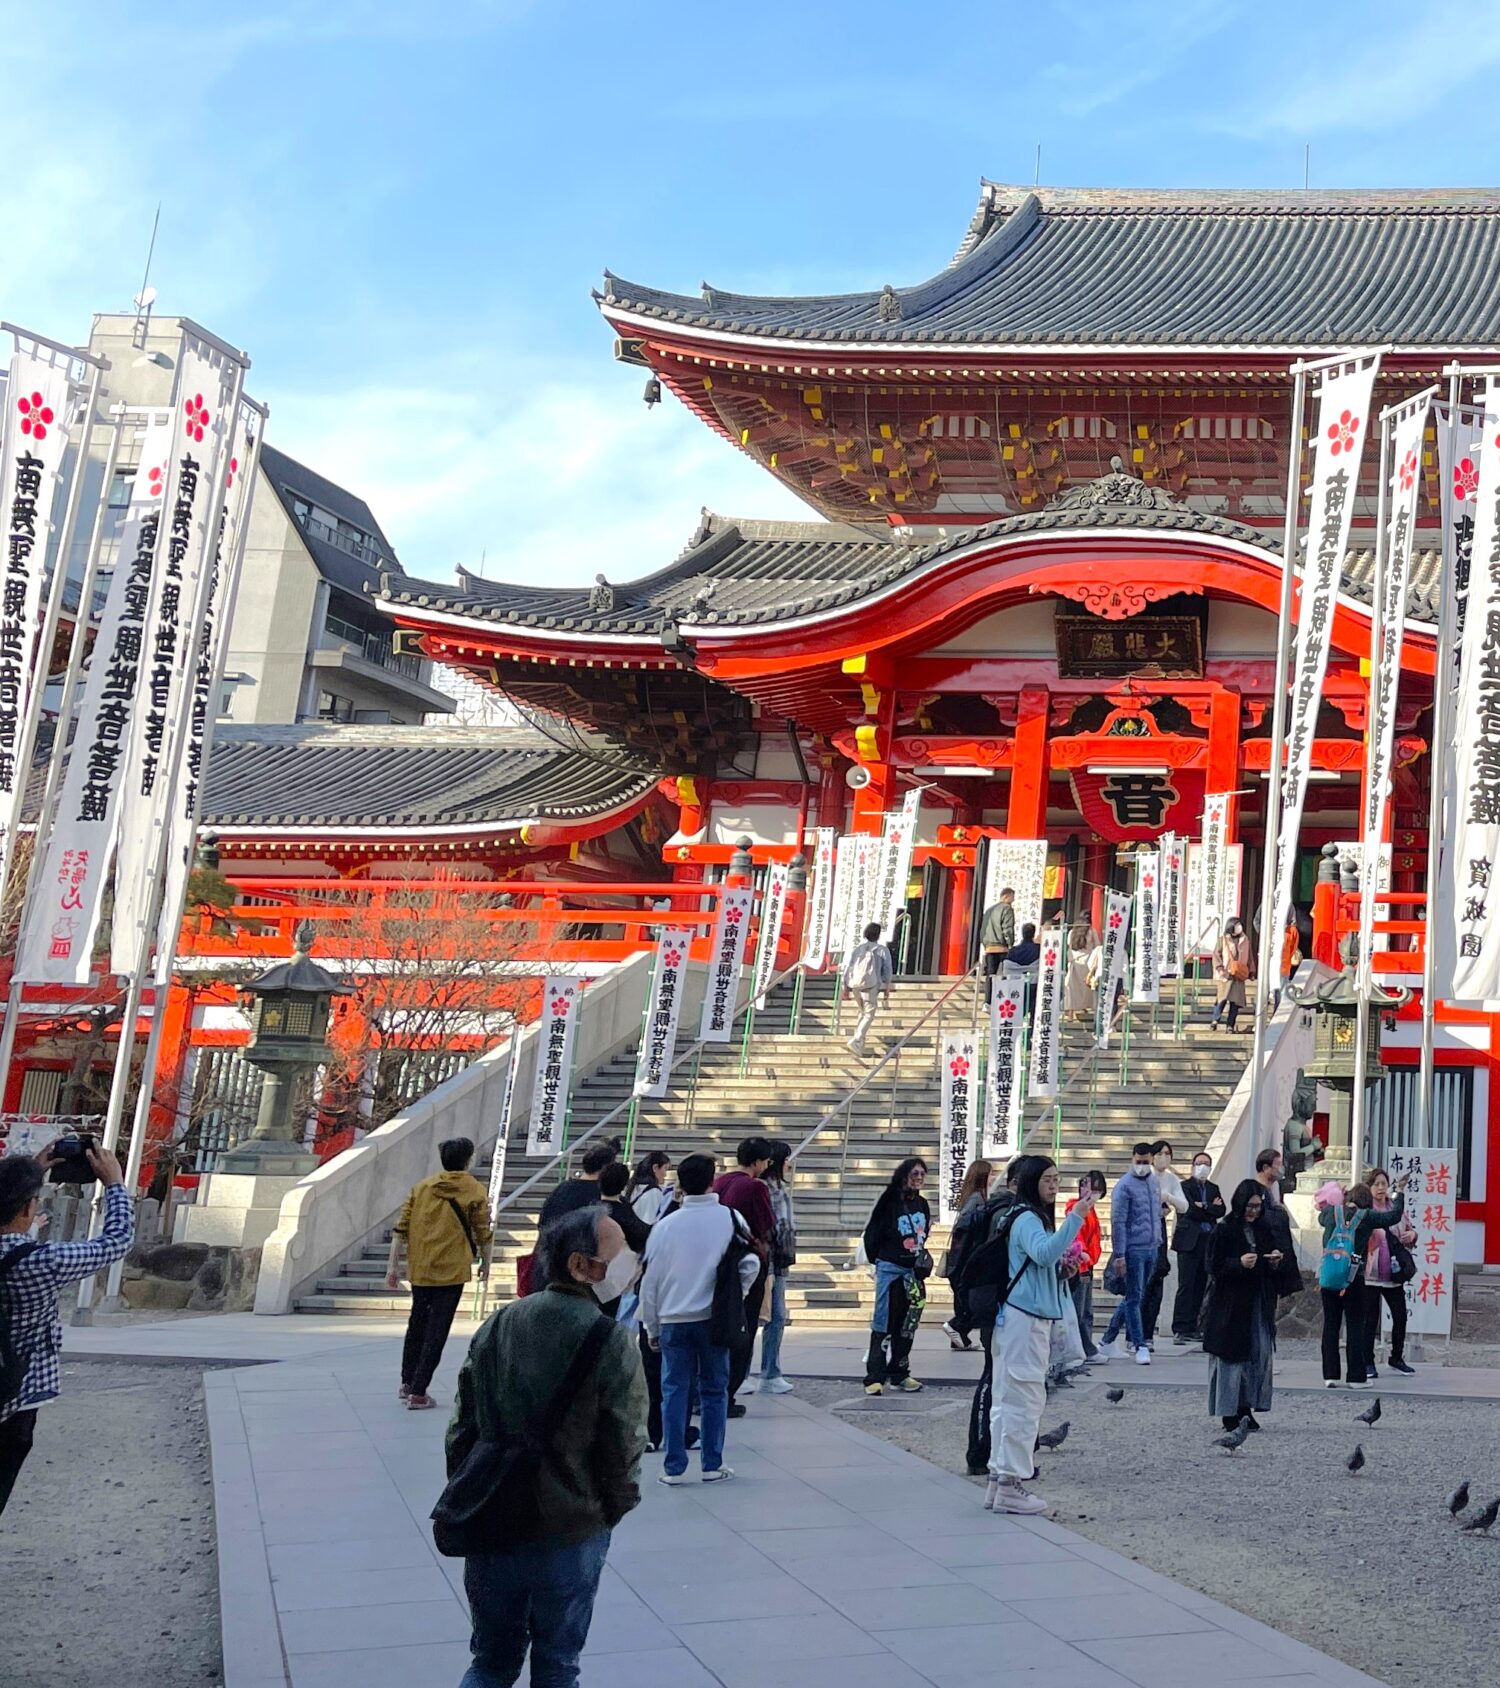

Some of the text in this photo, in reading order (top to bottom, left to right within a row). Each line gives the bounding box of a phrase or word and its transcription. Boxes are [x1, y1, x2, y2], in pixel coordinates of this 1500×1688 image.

[1087, 631, 1181, 660] 大悲殿
[1103, 775, 1177, 826] 音
[536, 1017, 566, 1144] 南無聖観世音菩薩
[992, 1020, 1014, 1146] 南無聖観世音菩薩
[1036, 967, 1055, 1085] 南無聖観世音菩薩
[1417, 1161, 1453, 1307] 諸縁吉祥
